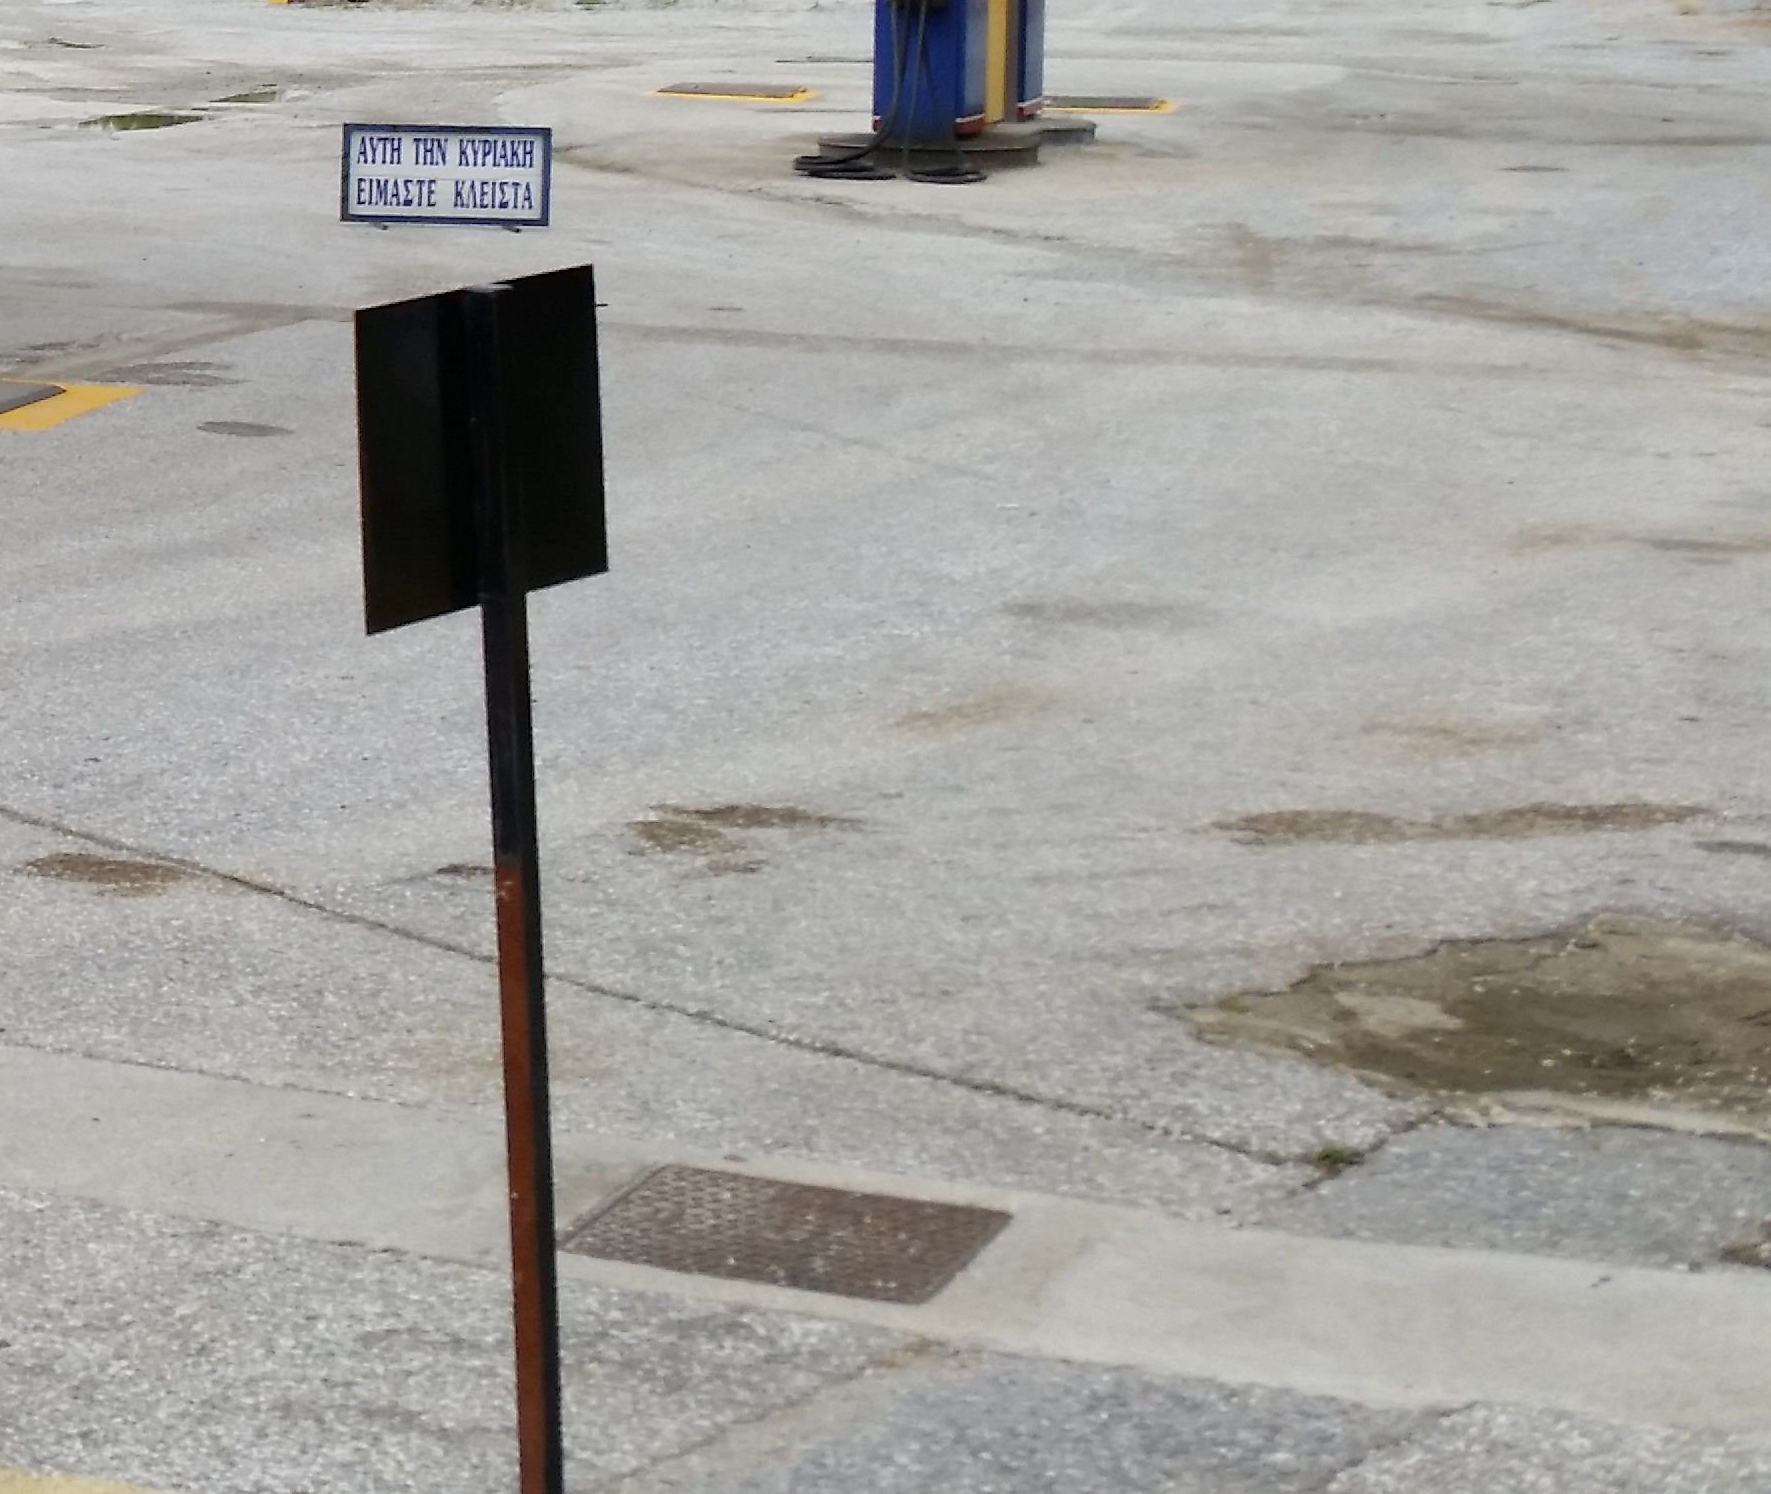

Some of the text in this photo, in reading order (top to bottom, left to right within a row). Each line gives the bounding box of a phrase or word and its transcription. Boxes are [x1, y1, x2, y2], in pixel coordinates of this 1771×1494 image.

[356, 135, 535, 169] ΑΥΤΗ ΤΗΝ ΚΥΡΙΑΚΗ
[356, 177, 534, 211] ΕΙΜΑΣΤΕ ΚΛΕΙΣΤΑ
